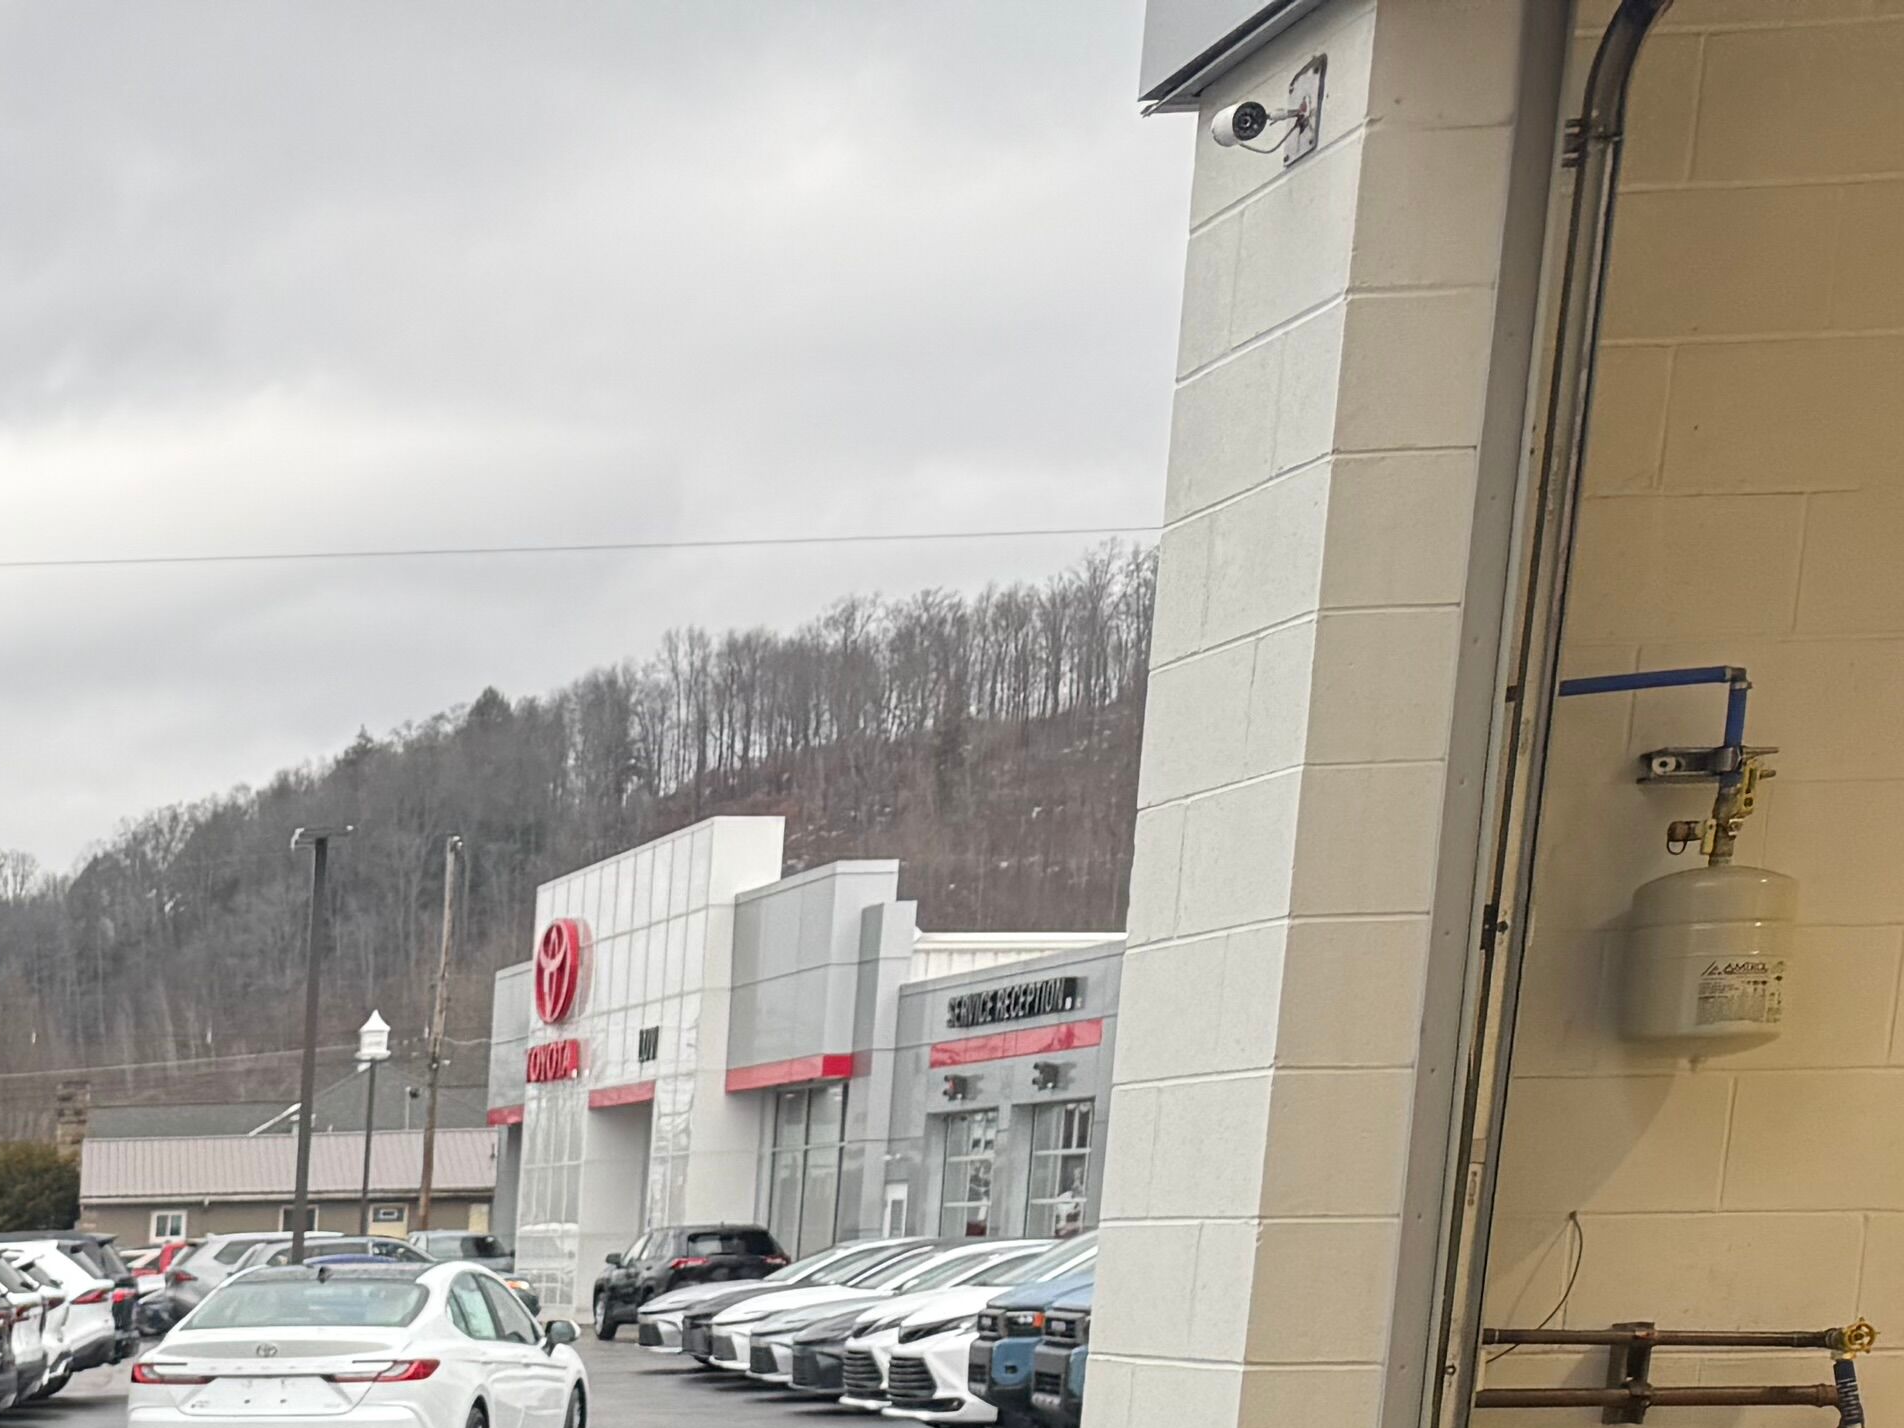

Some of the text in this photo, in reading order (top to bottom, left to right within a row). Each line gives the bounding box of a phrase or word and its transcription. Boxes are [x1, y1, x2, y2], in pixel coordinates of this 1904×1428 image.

[947, 977, 1067, 1029] SERVICE RECEPTION
[526, 1040, 576, 1083] TOYOTA
